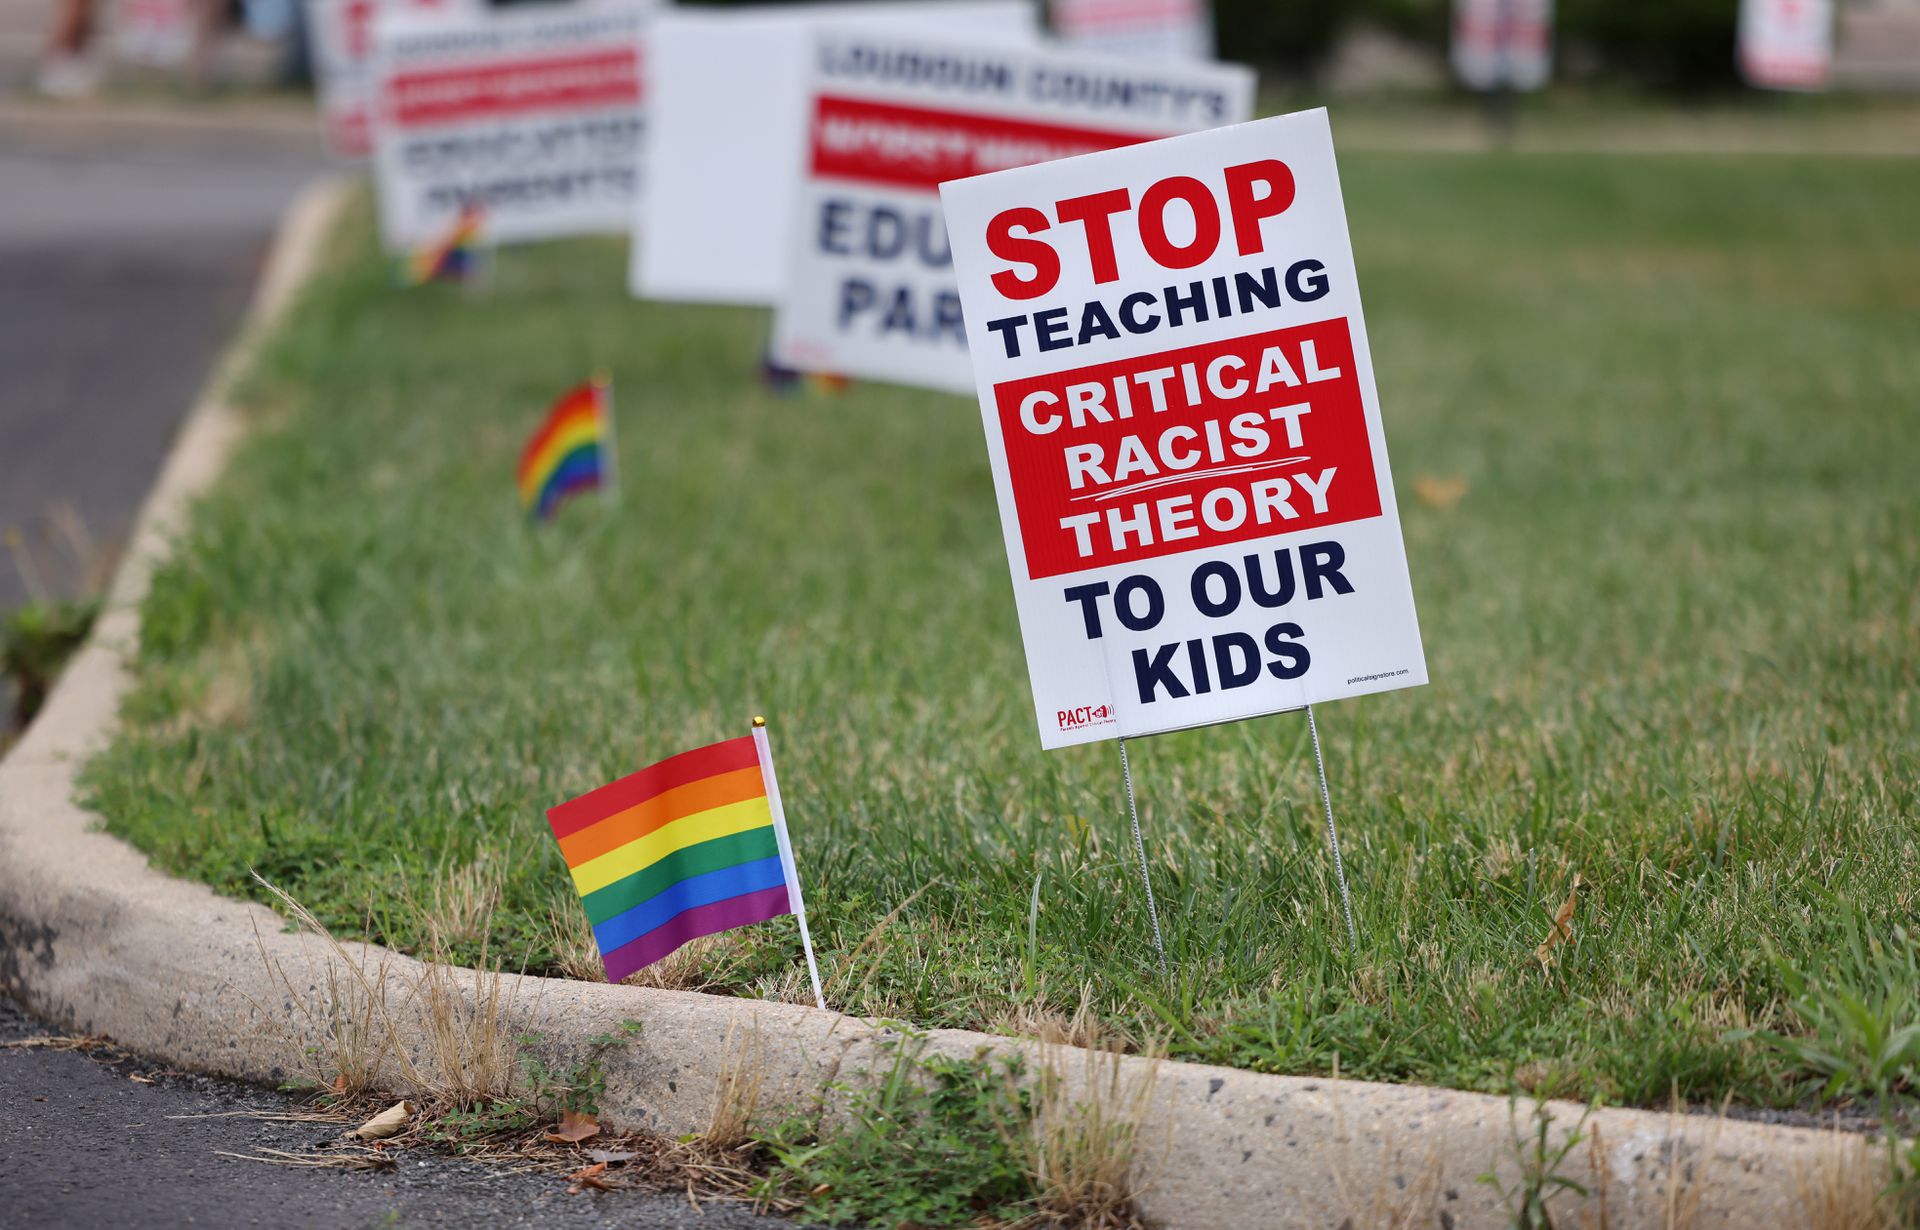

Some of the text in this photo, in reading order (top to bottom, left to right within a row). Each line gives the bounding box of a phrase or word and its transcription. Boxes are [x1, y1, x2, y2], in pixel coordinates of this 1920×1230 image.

[818, 200, 952, 268] EDU
[986, 159, 1296, 300] STOP
[986, 259, 1330, 359] TEACHING
[1019, 339, 1341, 435] CRITICAL
[1063, 401, 1312, 490] RACIST
[1059, 466, 1337, 558] THEORY
[1063, 540, 1356, 640] TO OUR
[1131, 622, 1311, 704] KIDS
[1347, 668, 1409, 685] politicalsignstore.com
[1057, 705, 1092, 727] PACT
